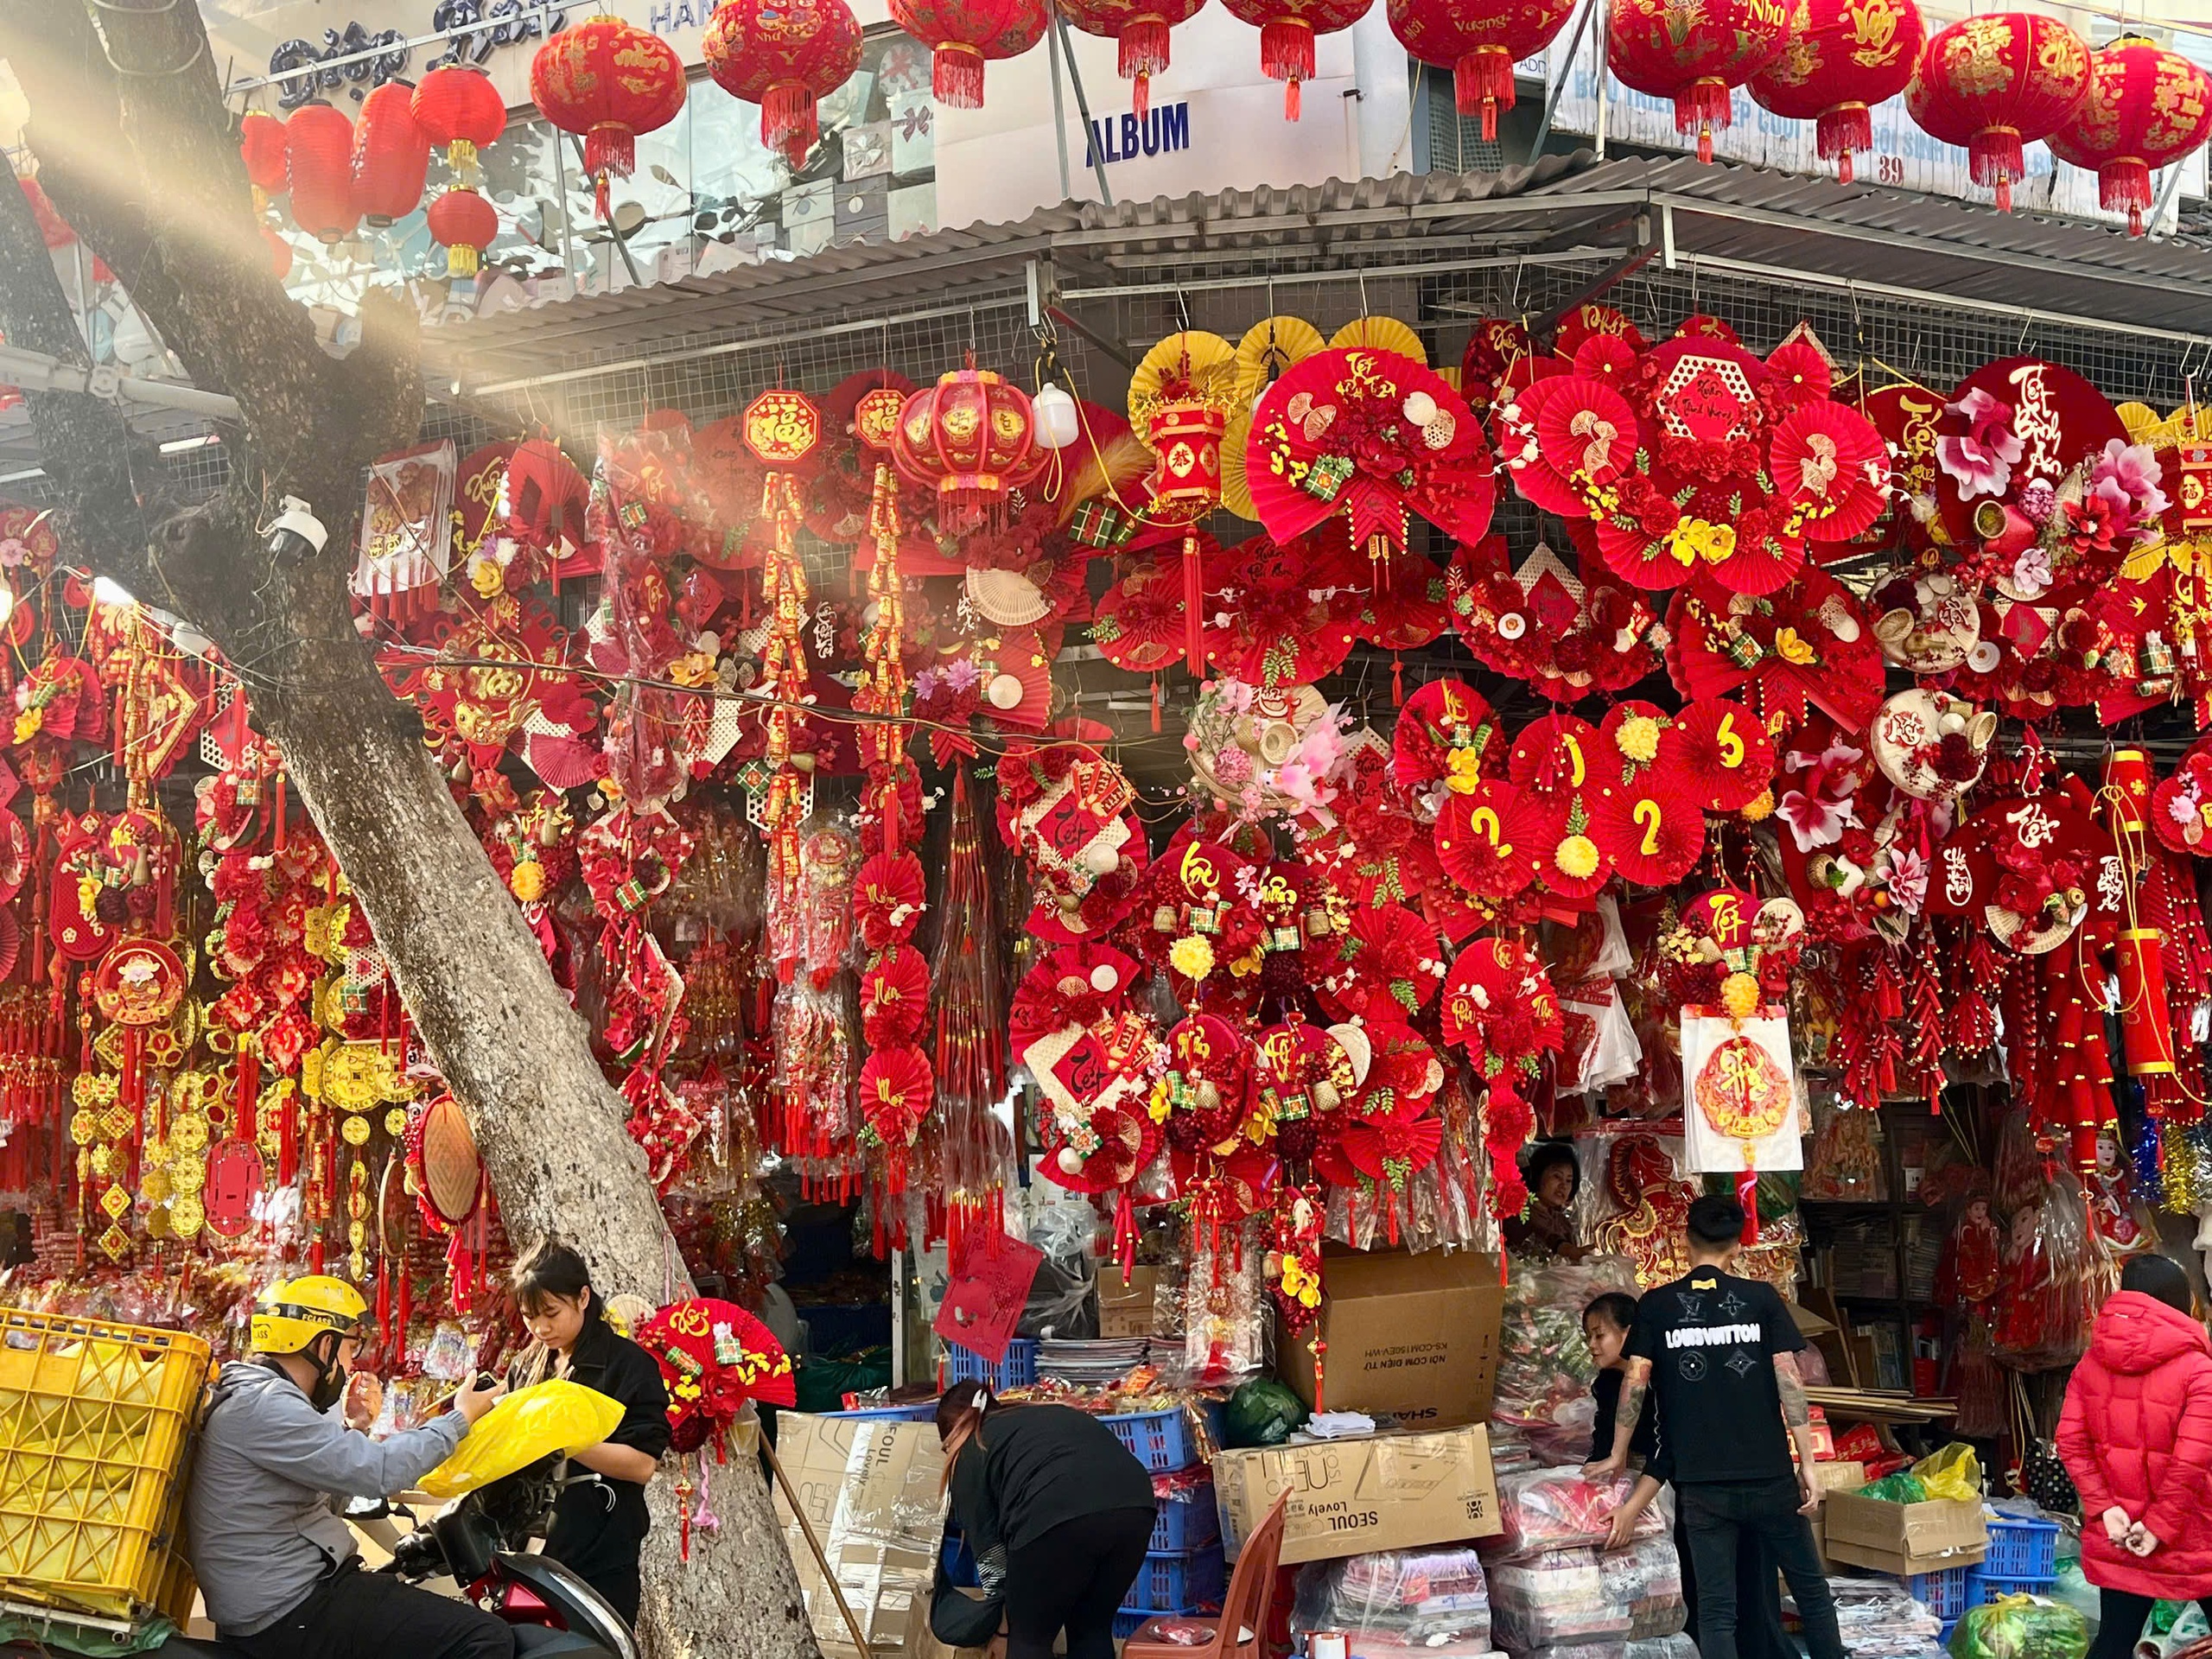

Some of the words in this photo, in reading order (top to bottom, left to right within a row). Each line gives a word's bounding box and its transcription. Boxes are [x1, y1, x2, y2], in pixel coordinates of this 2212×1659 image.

[1086, 102, 1189, 168] ALBUM
[1879, 155, 1904, 184] 39
[2009, 363, 2056, 416] Tết
[759, 403, 804, 443] 福
[1633, 798, 1662, 855] 2
[1307, 1501, 1348, 1516] Lovely
[1331, 1510, 1378, 1531] SEOUL
